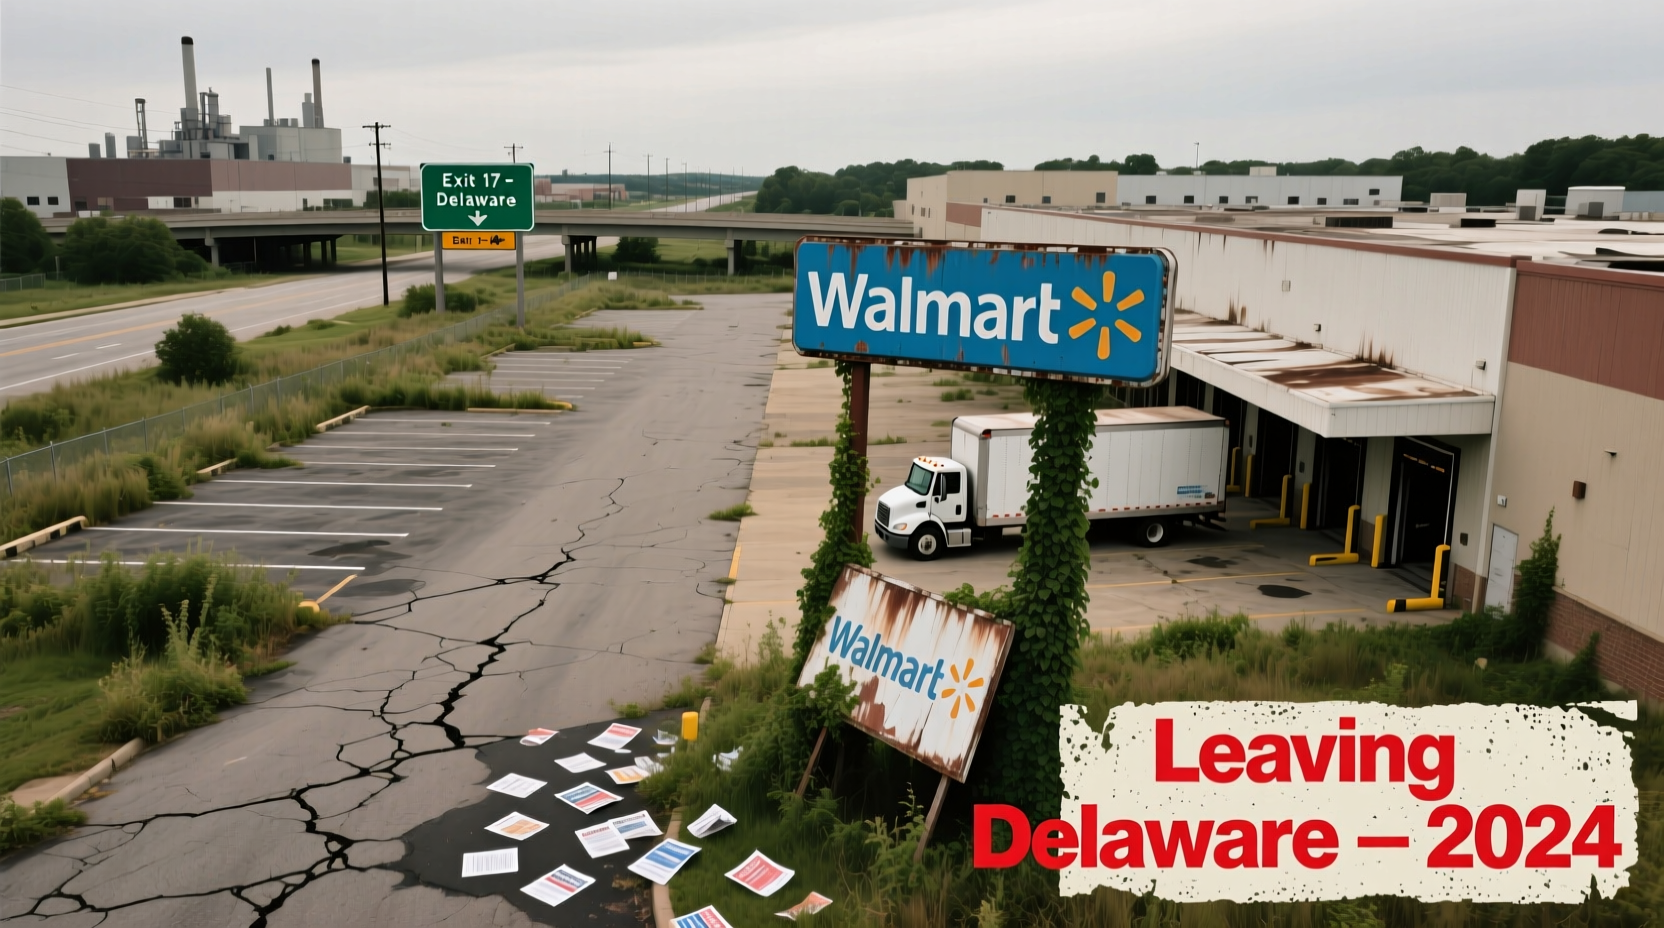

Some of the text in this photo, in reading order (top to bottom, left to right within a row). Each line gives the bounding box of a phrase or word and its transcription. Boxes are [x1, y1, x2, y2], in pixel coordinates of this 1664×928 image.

[436, 192, 516, 207] Delaware
[443, 173, 475, 187] Exit
[483, 173, 501, 188] 17
[808, 271, 1061, 344] Walmart
[829, 616, 945, 701] Walmart
